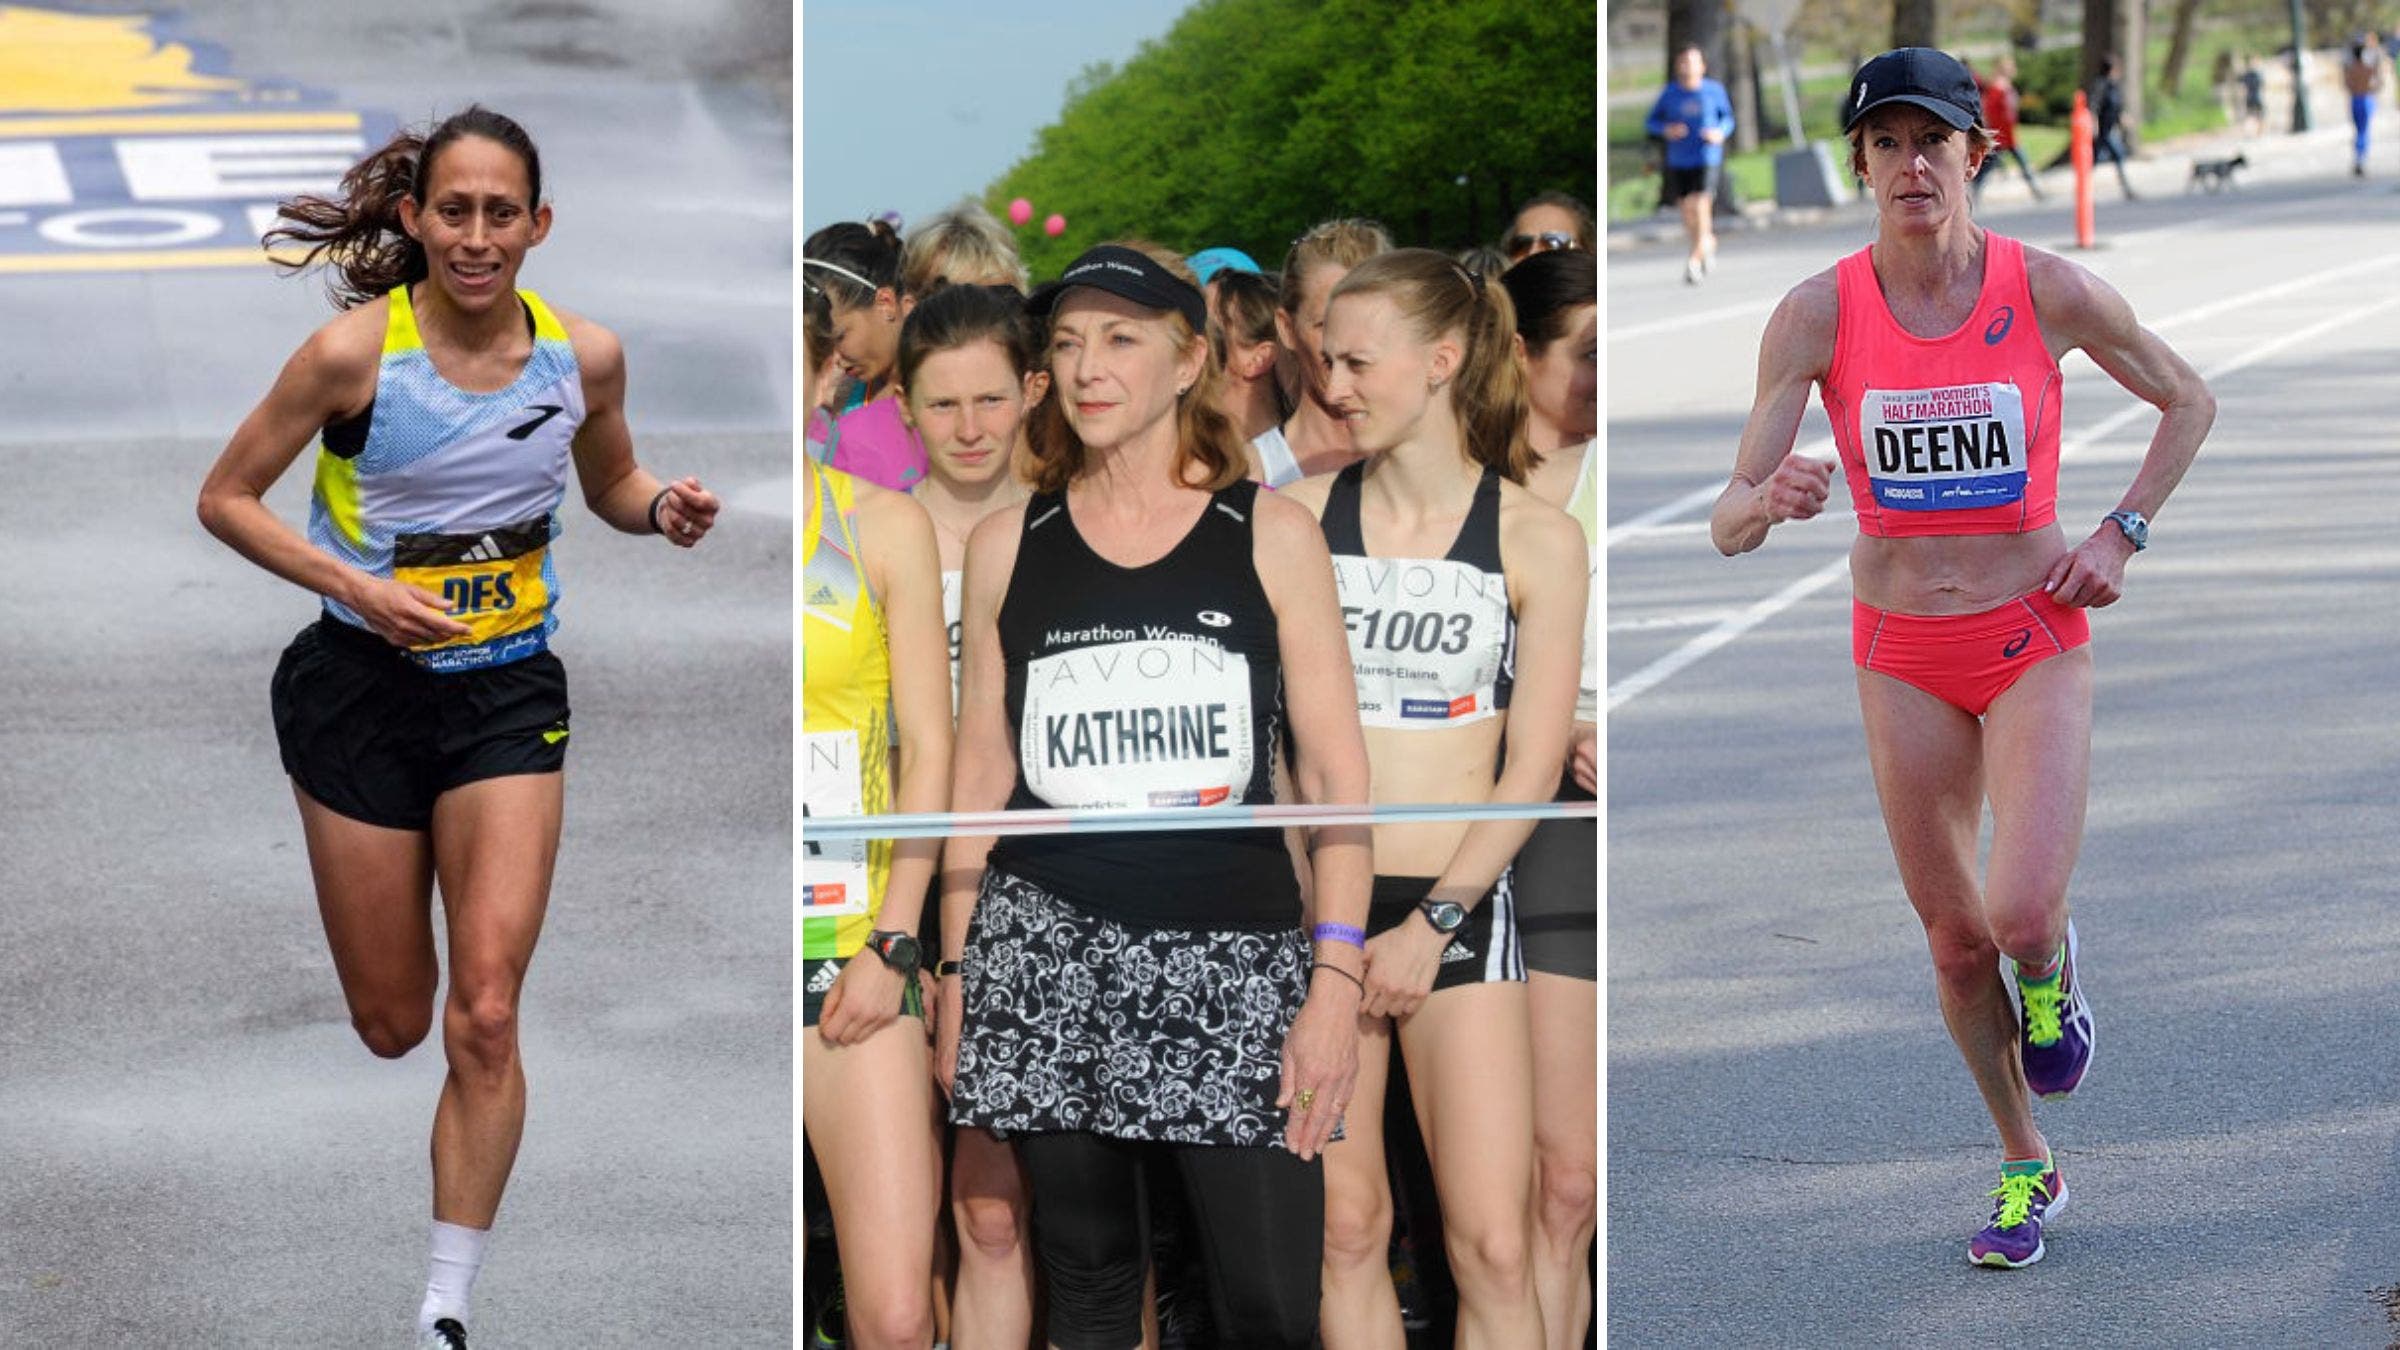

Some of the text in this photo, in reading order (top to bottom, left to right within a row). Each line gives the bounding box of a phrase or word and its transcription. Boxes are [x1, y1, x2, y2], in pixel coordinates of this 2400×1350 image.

[1882, 399, 1992, 420] HALF MARATHON
[1875, 421, 2011, 474] DEENA
[1045, 624, 1136, 647] Marathon
[1049, 646, 1225, 690] AVON
[1046, 703, 1230, 769] KATHRINE
